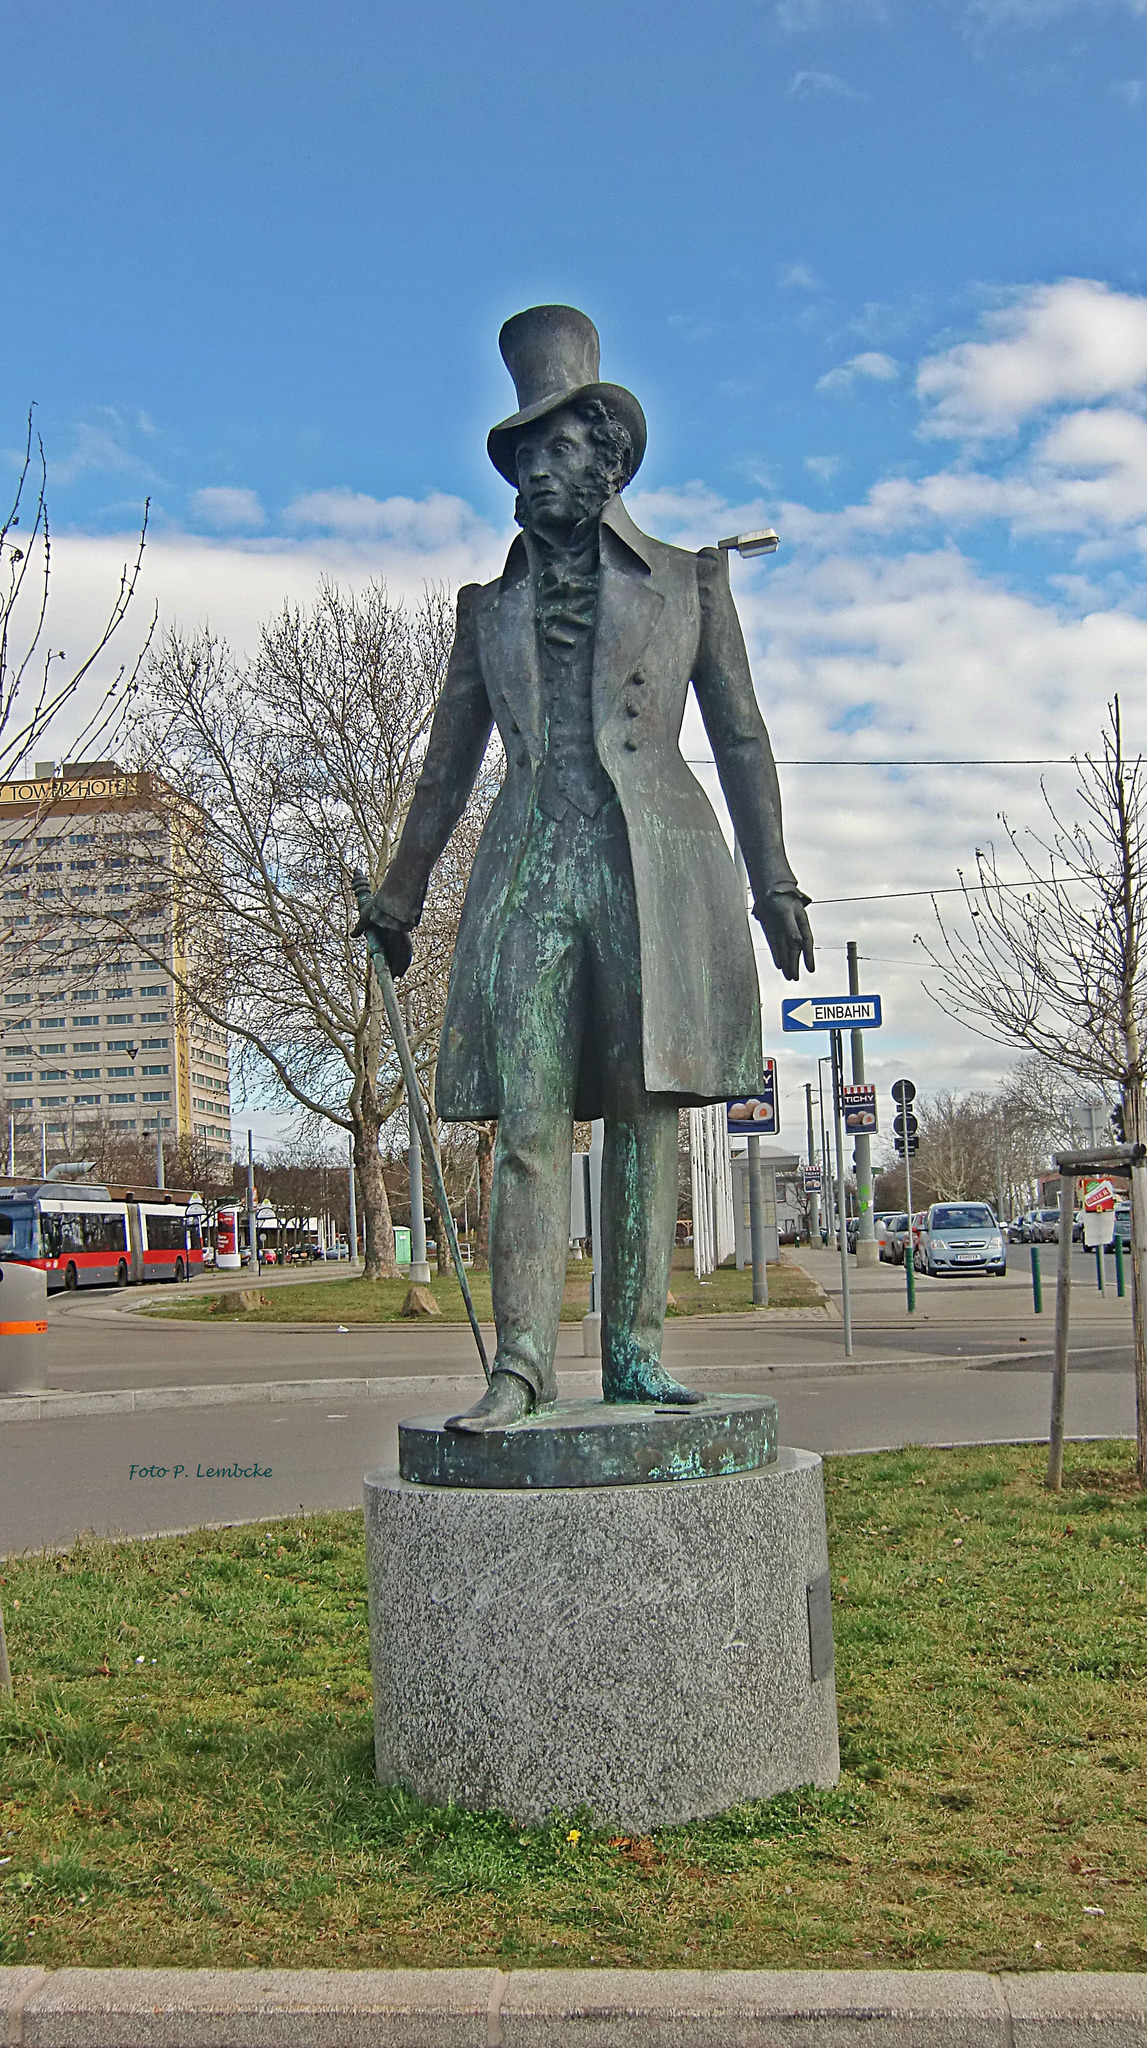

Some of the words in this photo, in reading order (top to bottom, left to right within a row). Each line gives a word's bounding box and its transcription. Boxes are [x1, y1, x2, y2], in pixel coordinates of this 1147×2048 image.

[10, 782, 71, 800] TOWER
[815, 1005, 870, 1020] EINBAHN
[844, 1095, 874, 1103] TICHY
